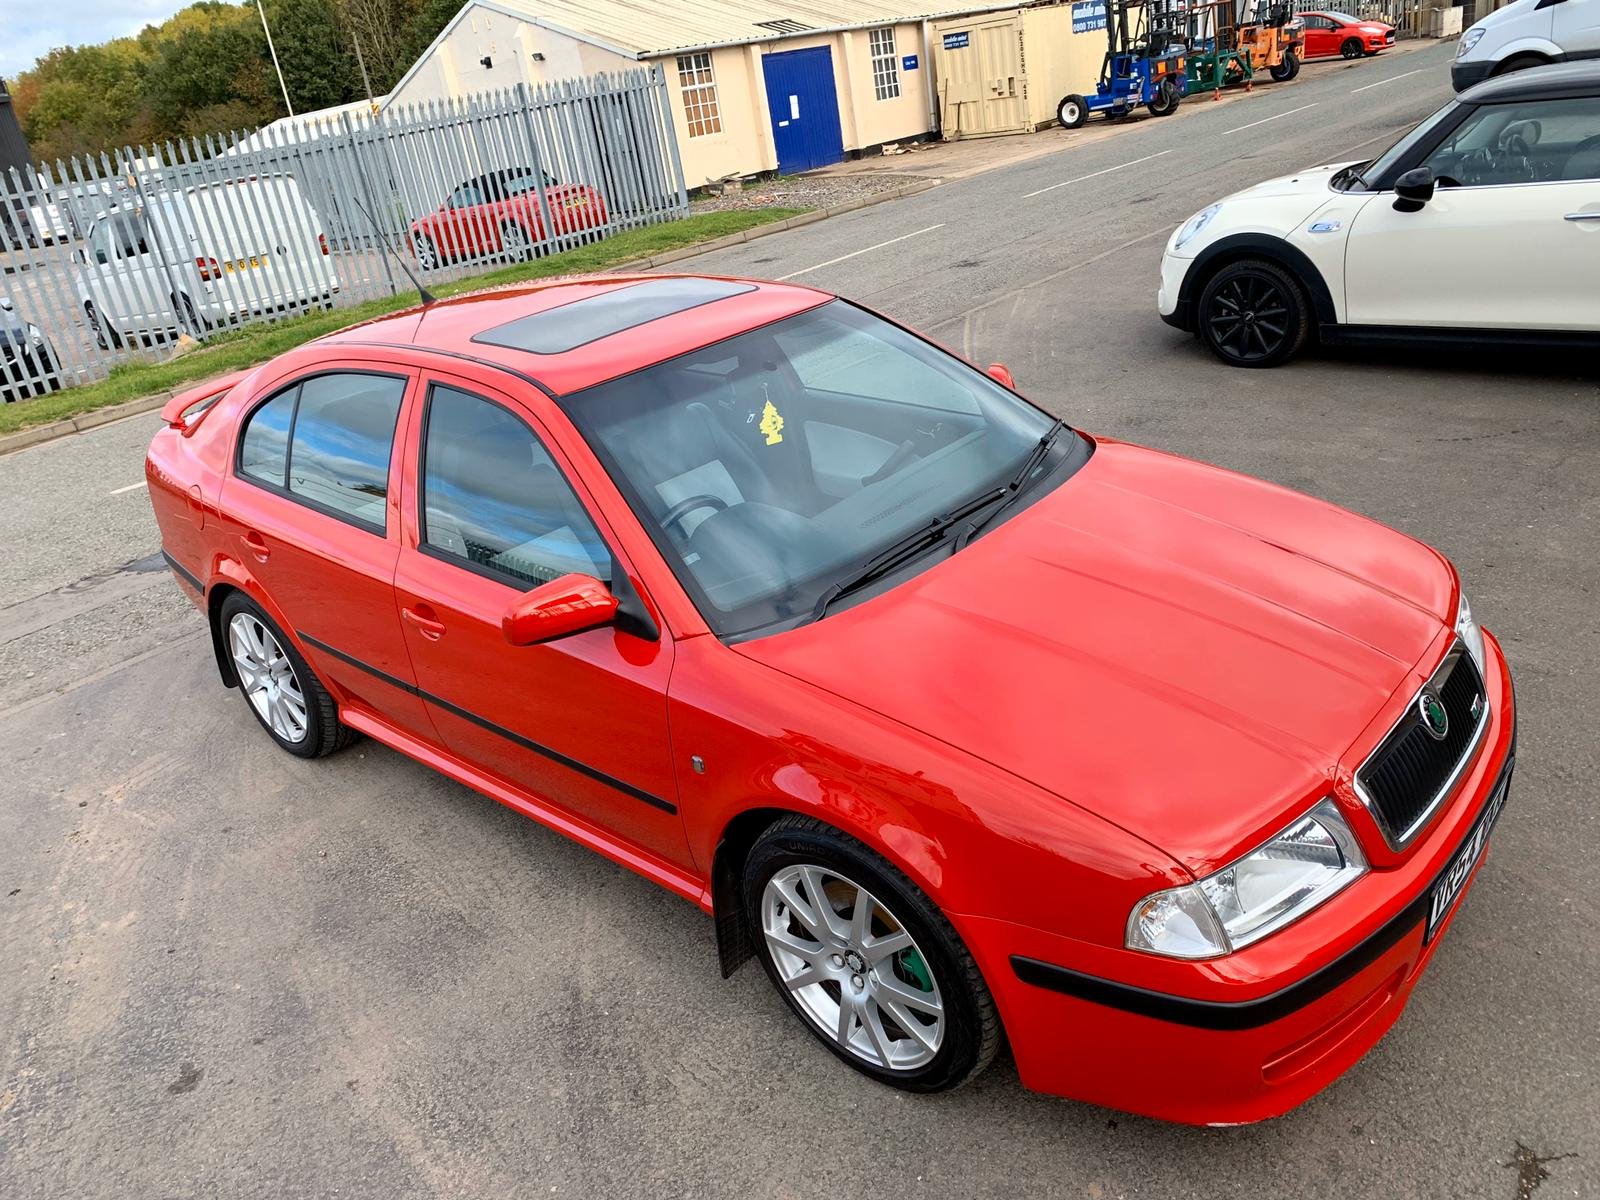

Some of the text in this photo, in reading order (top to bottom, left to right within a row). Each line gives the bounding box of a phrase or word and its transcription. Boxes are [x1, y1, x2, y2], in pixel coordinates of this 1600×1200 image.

[1073, 3, 1106, 19] mobile min
[1073, 22, 1086, 32] 0800
[1087, 20, 1097, 30] 731
